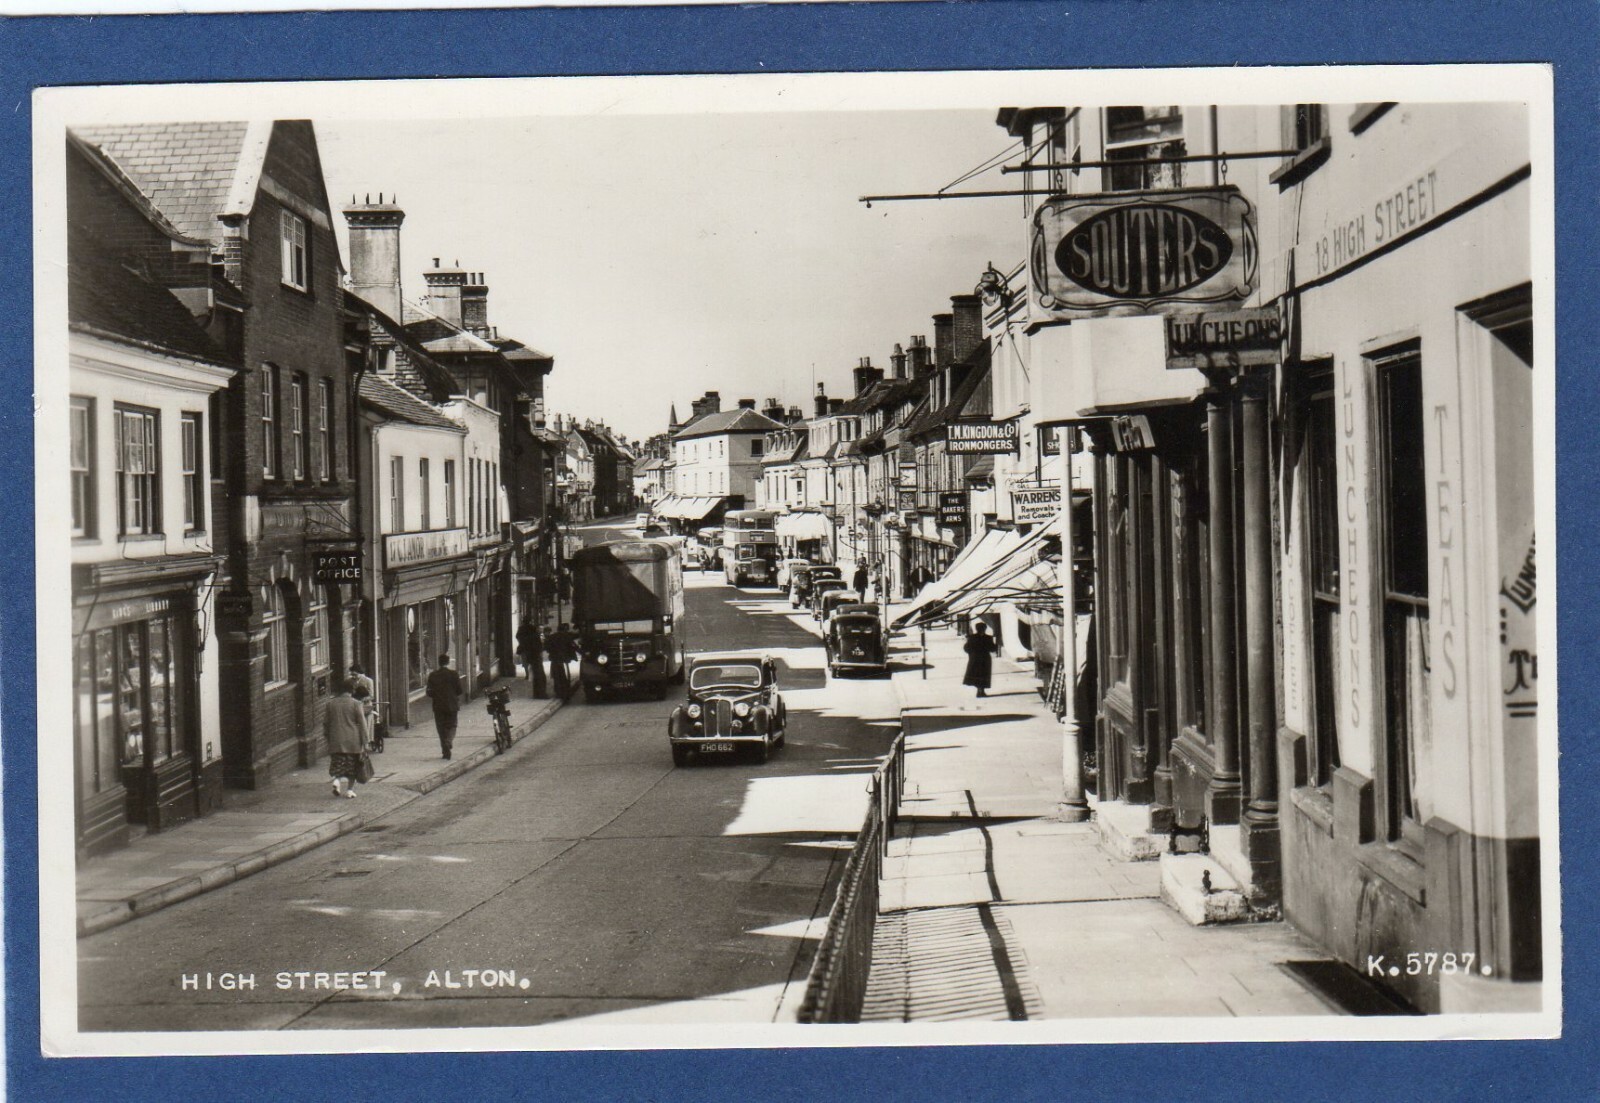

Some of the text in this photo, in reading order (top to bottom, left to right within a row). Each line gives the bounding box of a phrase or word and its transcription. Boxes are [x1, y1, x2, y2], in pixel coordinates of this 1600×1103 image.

[1315, 170, 1437, 275] 18 HIGH STREET
[1071, 208, 1220, 295] SOUTERS
[1167, 318, 1280, 357] LUNCHEONS
[1014, 491, 1061, 504] WARRENS
[1021, 505, 1054, 513] Removals
[320, 556, 357, 567] POST
[1341, 361, 1361, 728] LUNCHEONS
[1433, 404, 1457, 700] TEAS
[317, 568, 361, 579] OFFICE
